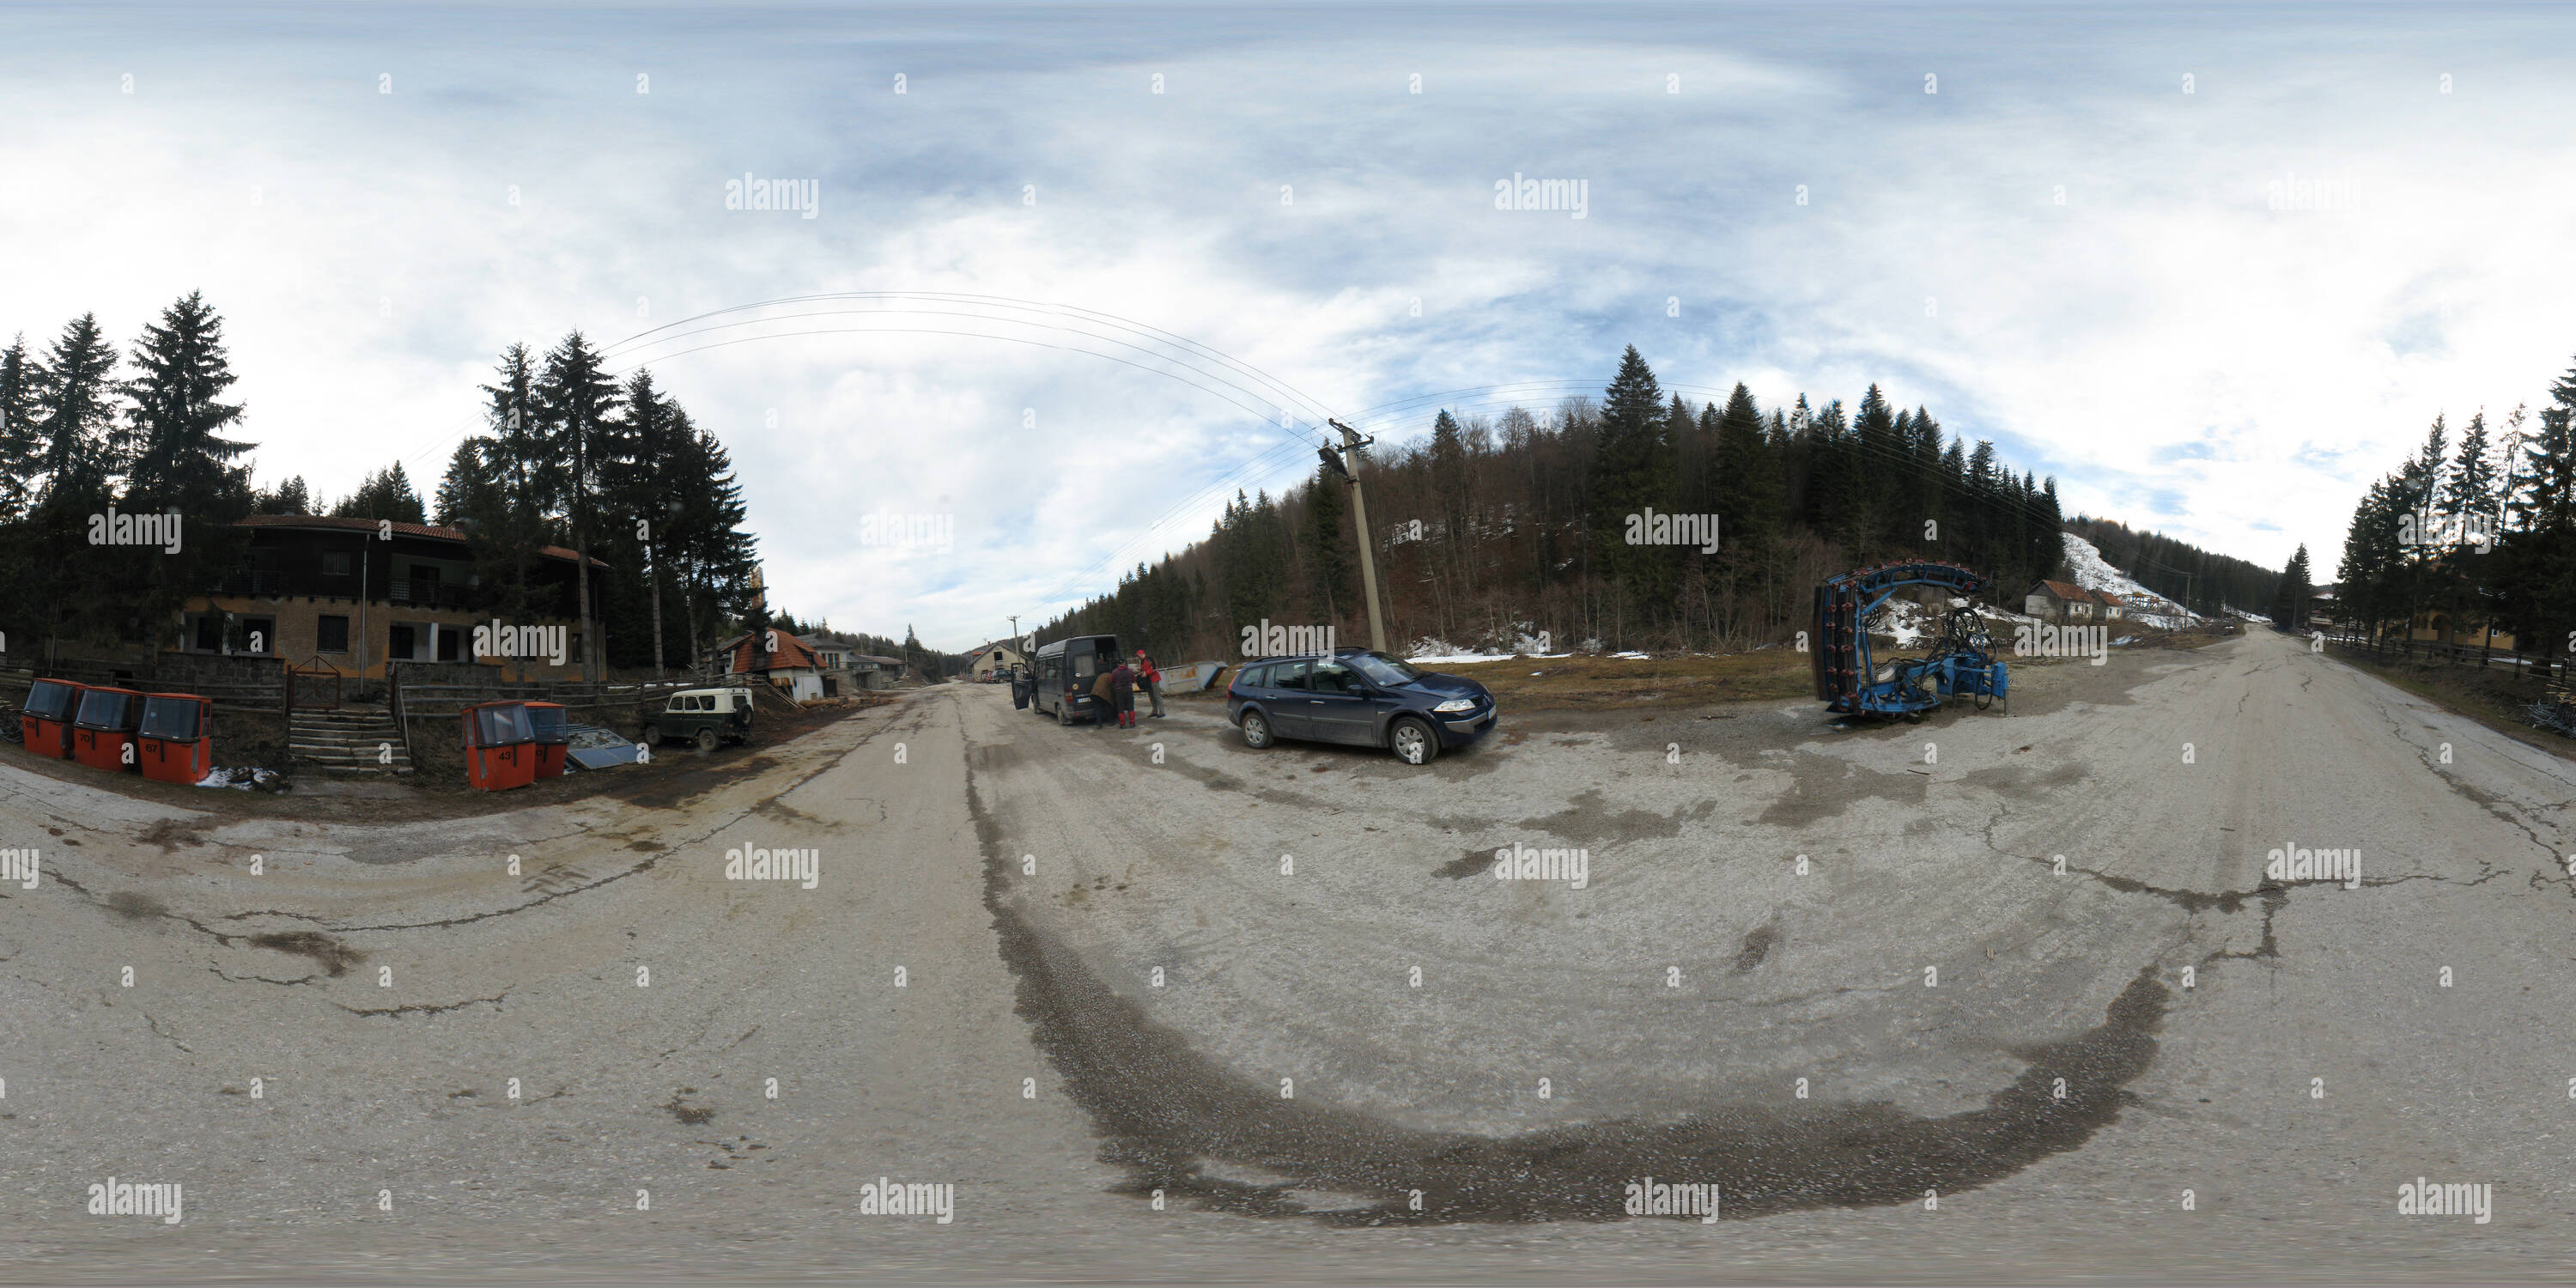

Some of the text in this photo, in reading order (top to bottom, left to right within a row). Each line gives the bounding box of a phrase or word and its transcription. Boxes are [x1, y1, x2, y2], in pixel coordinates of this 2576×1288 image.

[79, 733, 90, 743] 70
[145, 743, 158, 753] 67
[498, 750, 511, 761] 43
